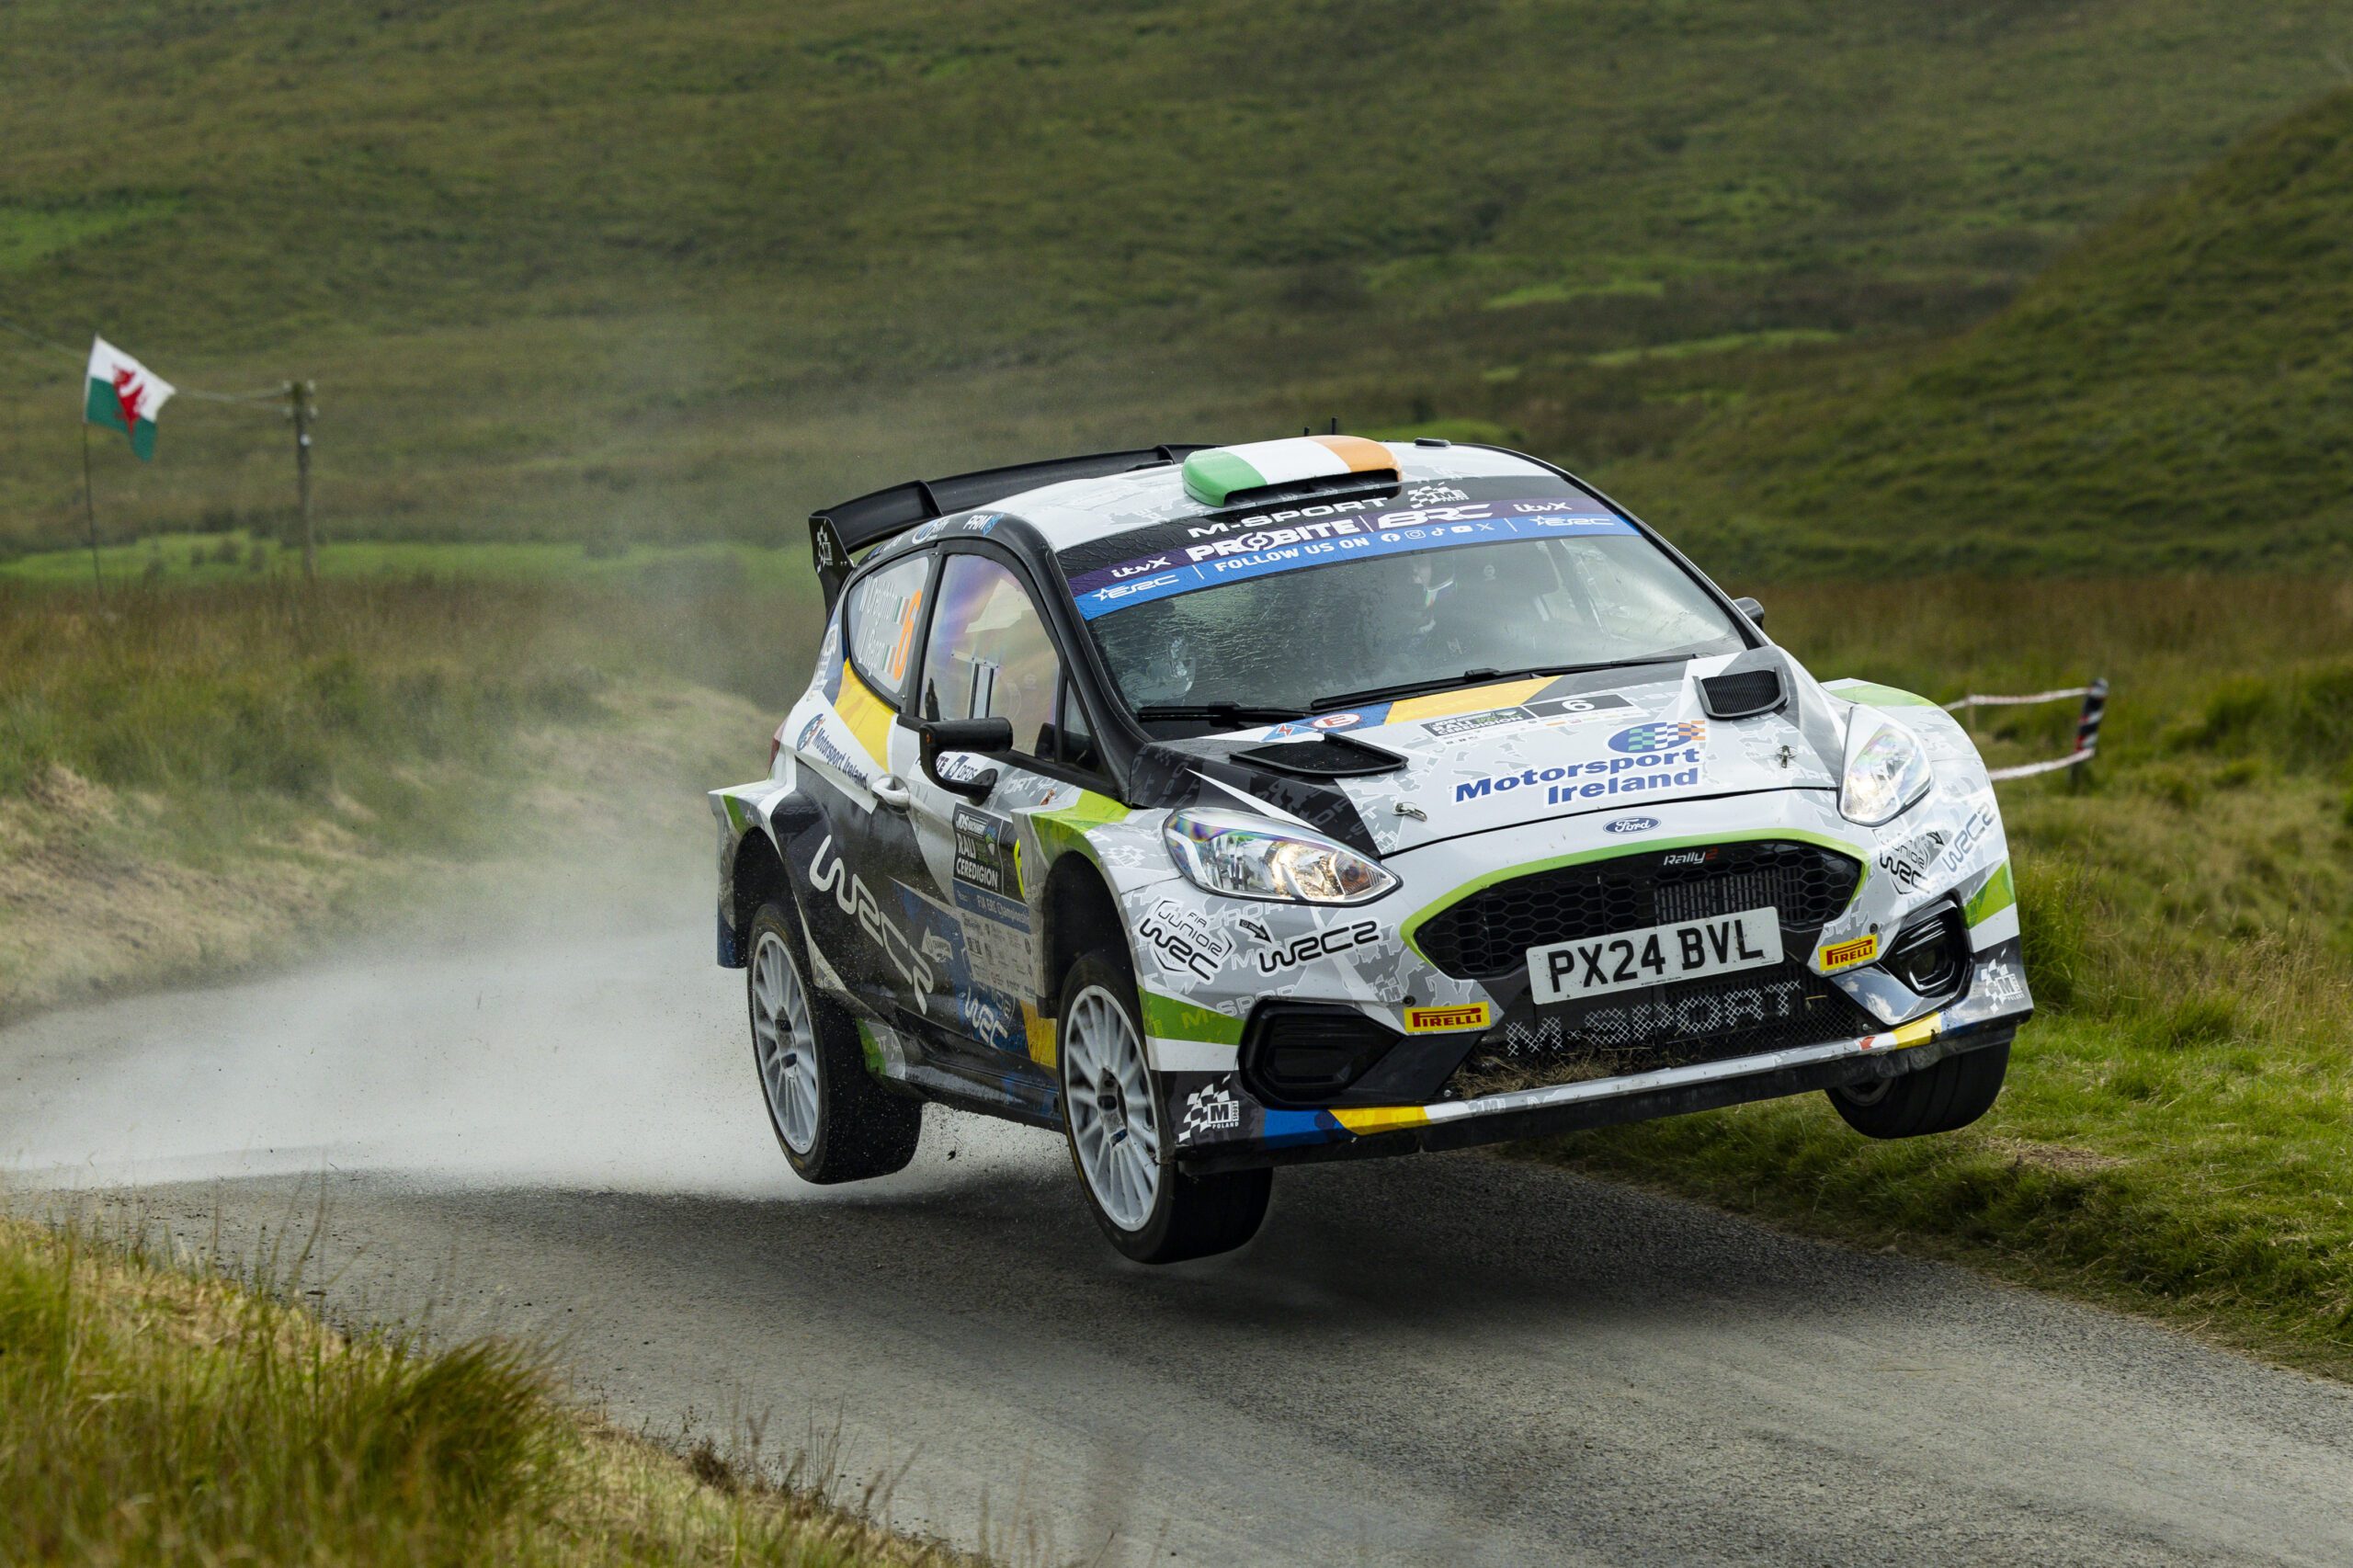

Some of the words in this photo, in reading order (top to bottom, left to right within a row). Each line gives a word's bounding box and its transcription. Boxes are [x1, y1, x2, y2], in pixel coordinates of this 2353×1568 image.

[1188, 497, 1388, 538] M-SPORT
[1513, 502, 1572, 513] itvX
[1185, 518, 1361, 562] PROBITE
[1214, 550, 1300, 573] FOLLOW
[1303, 542, 1335, 555] US
[1339, 536, 1370, 550] ON
[1110, 556, 1171, 578] itvX
[893, 588, 923, 680] 6
[1323, 715, 1351, 727] E
[1562, 699, 1596, 711] 6
[813, 728, 846, 770] Motorsport
[842, 756, 869, 790] Ireland
[1456, 748, 1699, 802] Motorsport
[1548, 767, 1699, 805] Ireland
[1614, 818, 1652, 833] Ford
[957, 833, 977, 859] RALI
[1664, 847, 1719, 866] Rally2
[956, 858, 998, 889] CEREDIGION
[1880, 850, 1930, 893] WRC
[1158, 911, 1222, 957] JUNIOR
[1188, 912, 1207, 927] FIA
[1140, 917, 1218, 981] WRC
[1259, 921, 1379, 972] WRC2
[1548, 934, 1665, 993] PX24
[1677, 919, 1764, 971] BVL
[1826, 939, 1872, 965] PIRELLI
[1412, 1007, 1482, 1028] PIRELLI
[1506, 980, 1801, 1056] M-SPORT
[1212, 1121, 1239, 1130] POLAND
